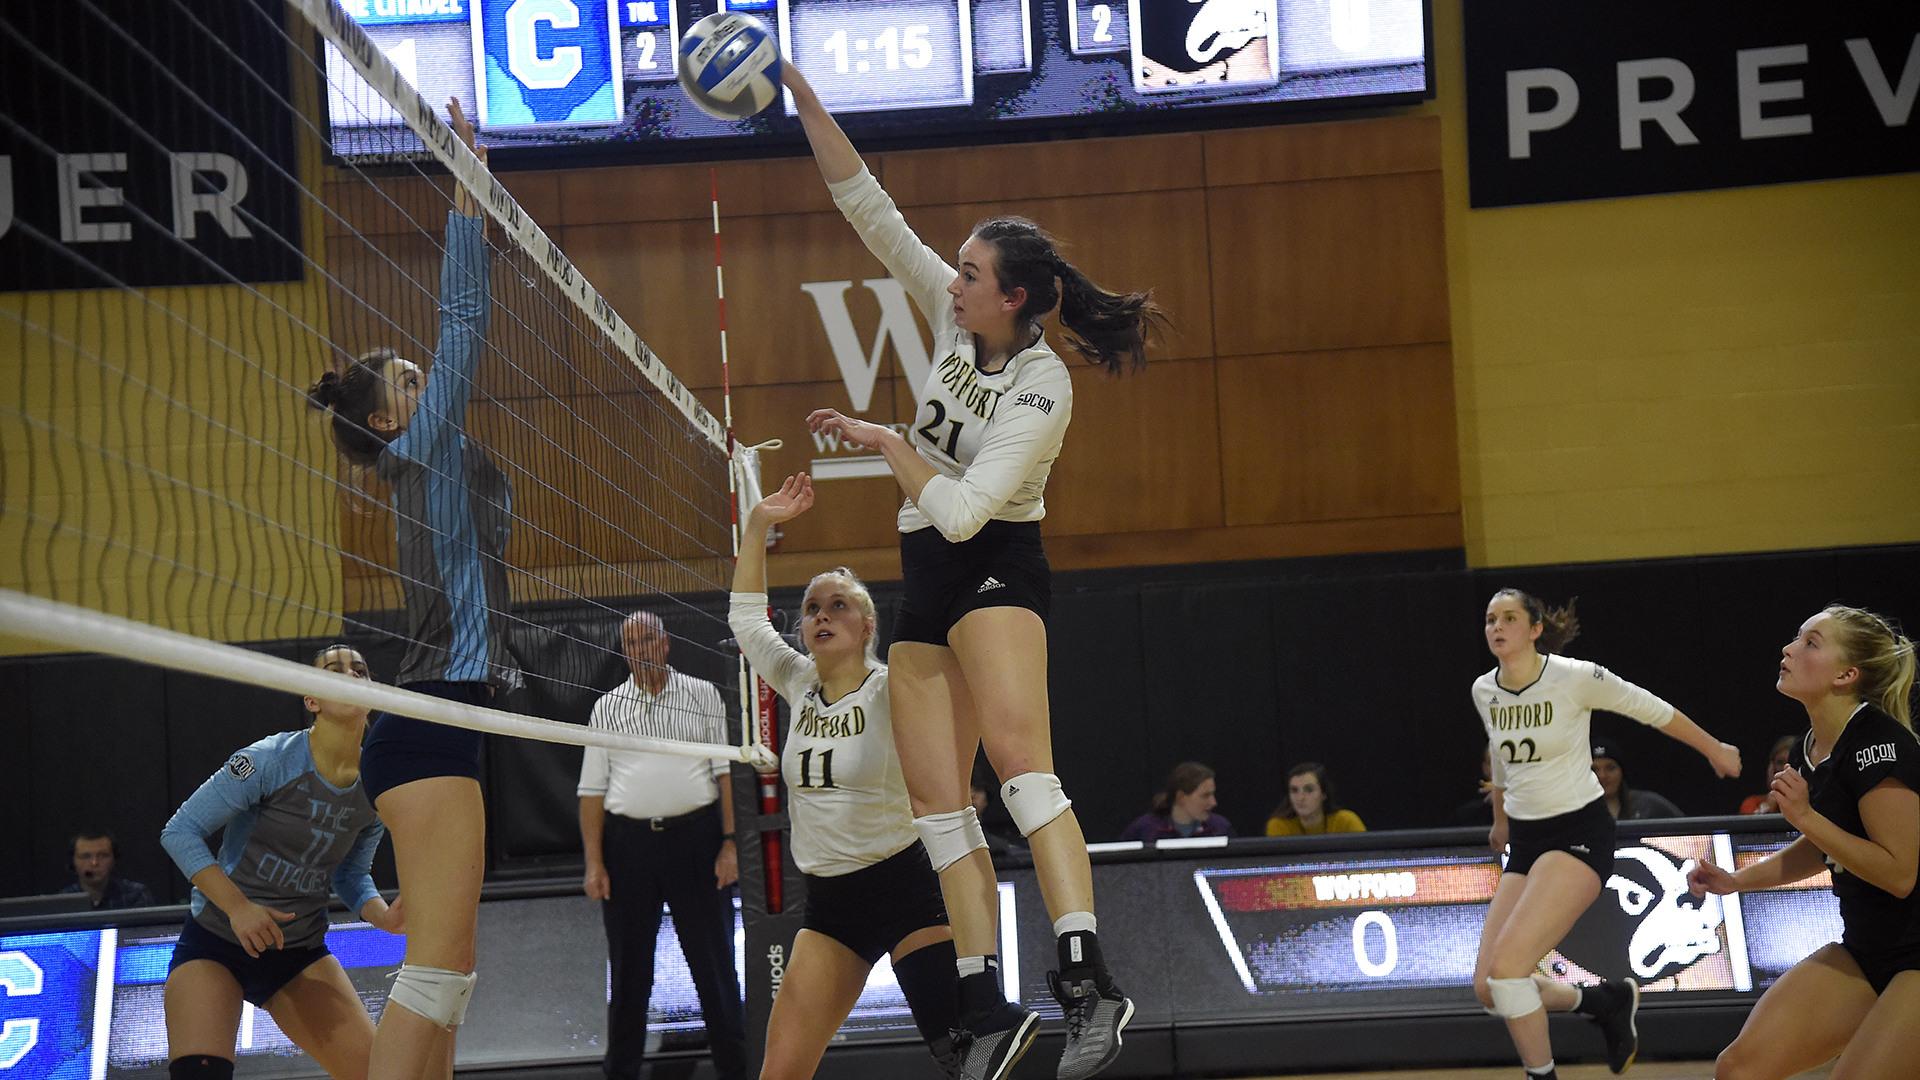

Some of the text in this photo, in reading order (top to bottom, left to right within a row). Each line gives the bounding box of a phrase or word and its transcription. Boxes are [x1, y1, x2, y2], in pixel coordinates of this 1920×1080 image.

[626, 2, 659, 23] TOL
[1091, 4, 1113, 43] 2
[636, 31, 658, 70] 2
[824, 25, 933, 74] 1:15
[1015, 393, 1056, 416] SOCON
[919, 399, 965, 464] 21
[1490, 701, 1553, 731] WOFFORD
[797, 747, 840, 788] 11
[1500, 737, 1542, 764] 22
[1855, 743, 1897, 771] SOCON
[307, 798, 356, 832] THE
[1312, 872, 1417, 901] WOFFORD
[1352, 911, 1399, 977] 0
